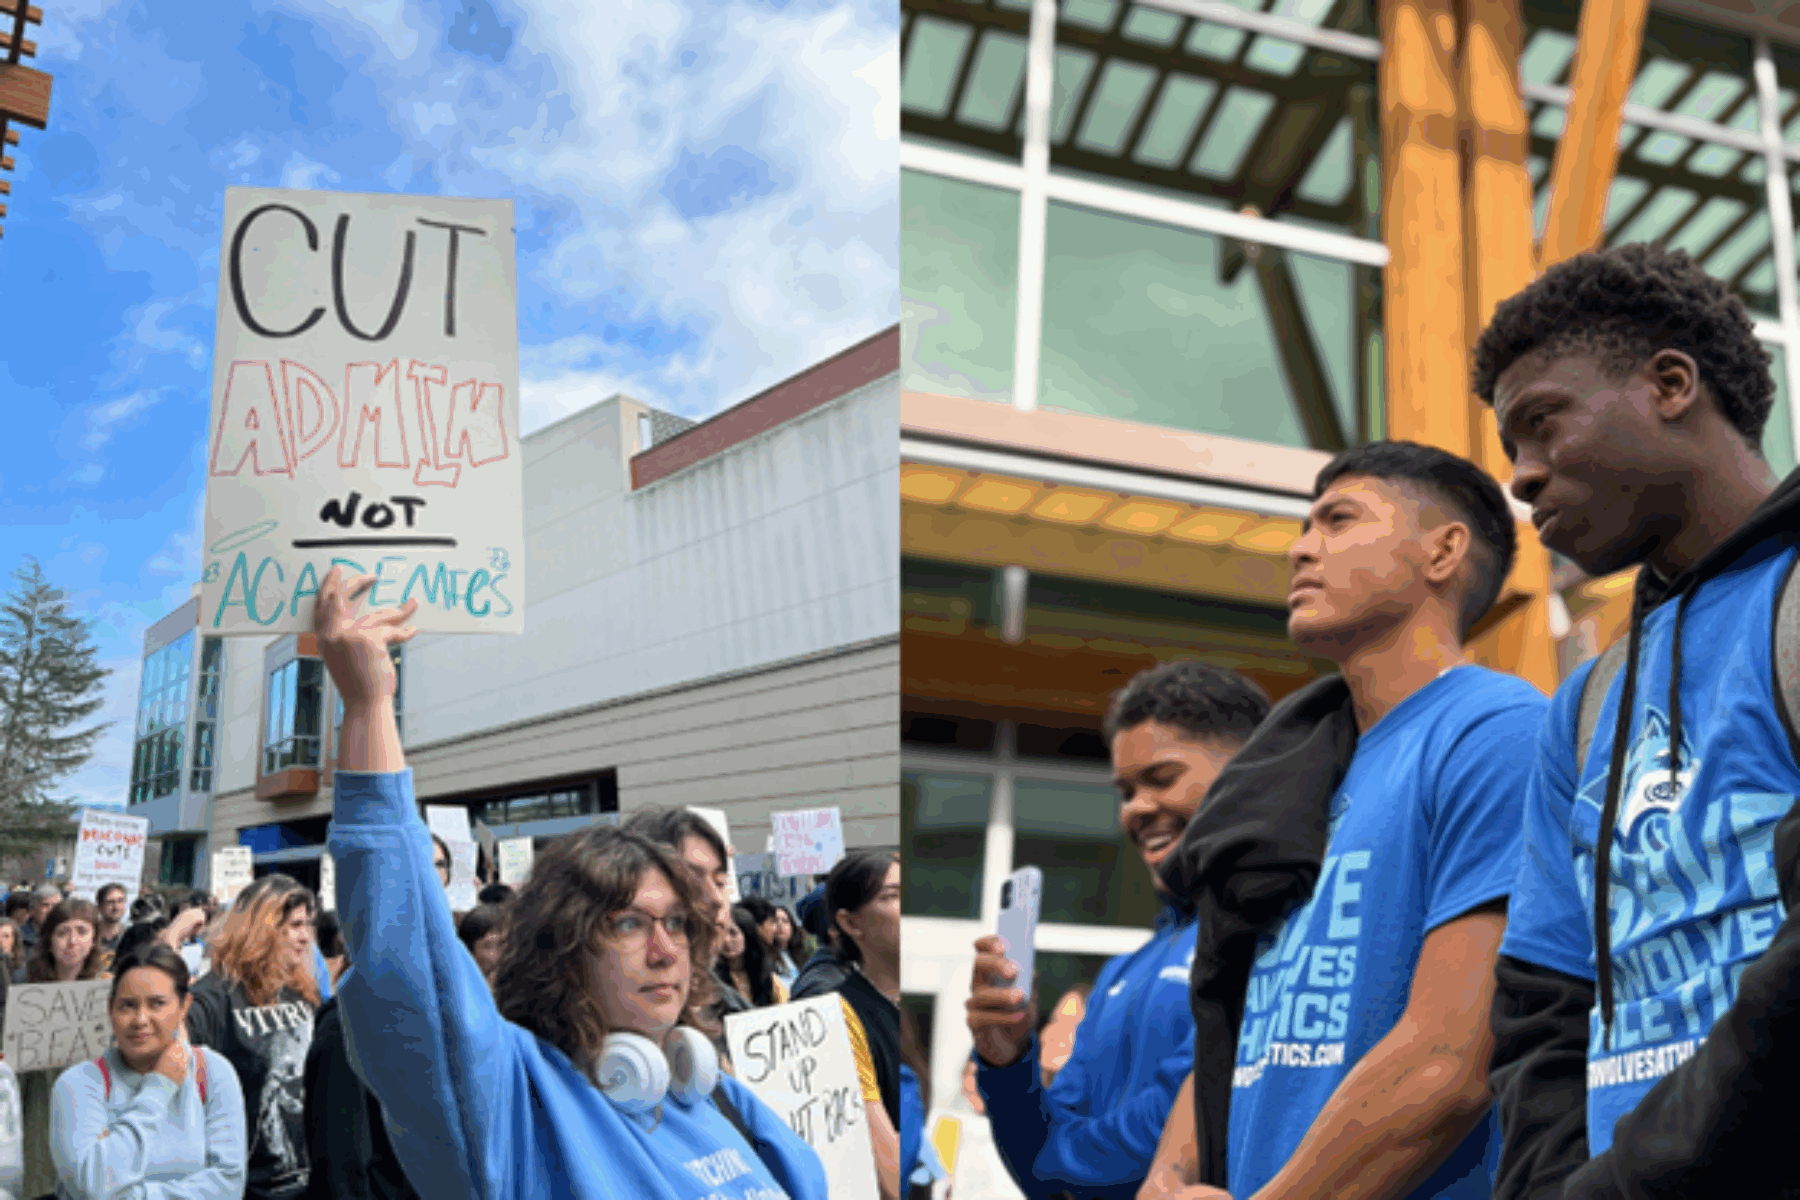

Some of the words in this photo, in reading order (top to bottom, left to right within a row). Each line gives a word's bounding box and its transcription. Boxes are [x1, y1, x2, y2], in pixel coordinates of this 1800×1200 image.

[229, 203, 487, 341] CUT
[210, 357, 510, 487] ADMIN
[319, 491, 427, 529] NOT
[17, 986, 110, 1028] SAVE
[744, 1006, 827, 1083] STAND
[789, 1056, 817, 1095] UP
